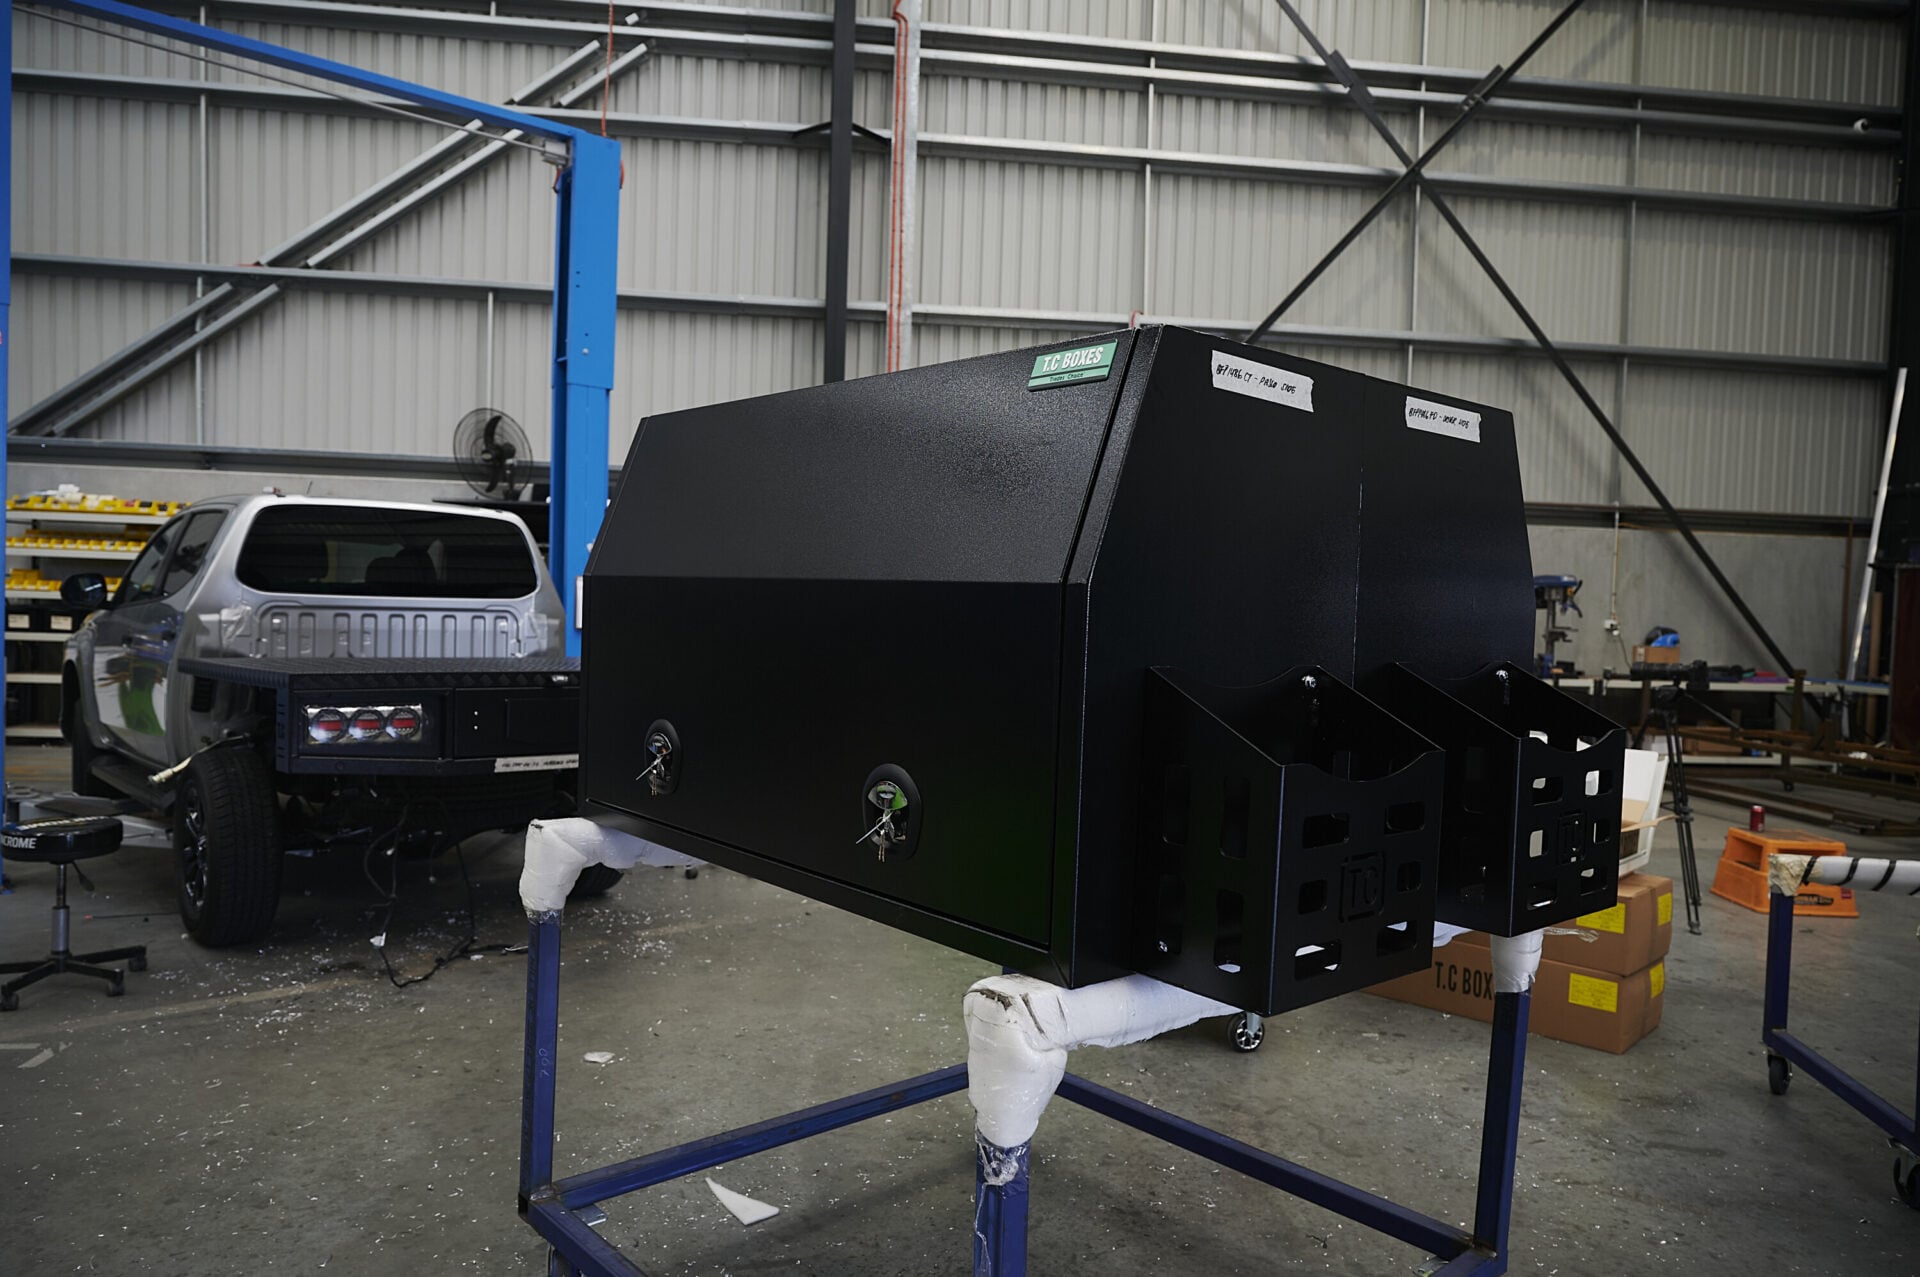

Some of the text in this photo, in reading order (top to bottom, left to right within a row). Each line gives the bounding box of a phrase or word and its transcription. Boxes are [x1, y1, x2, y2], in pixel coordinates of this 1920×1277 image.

[1043, 347, 1103, 372] T.C BOXES
[1349, 865, 1379, 909] TC
[1435, 961, 1458, 992] T.C
